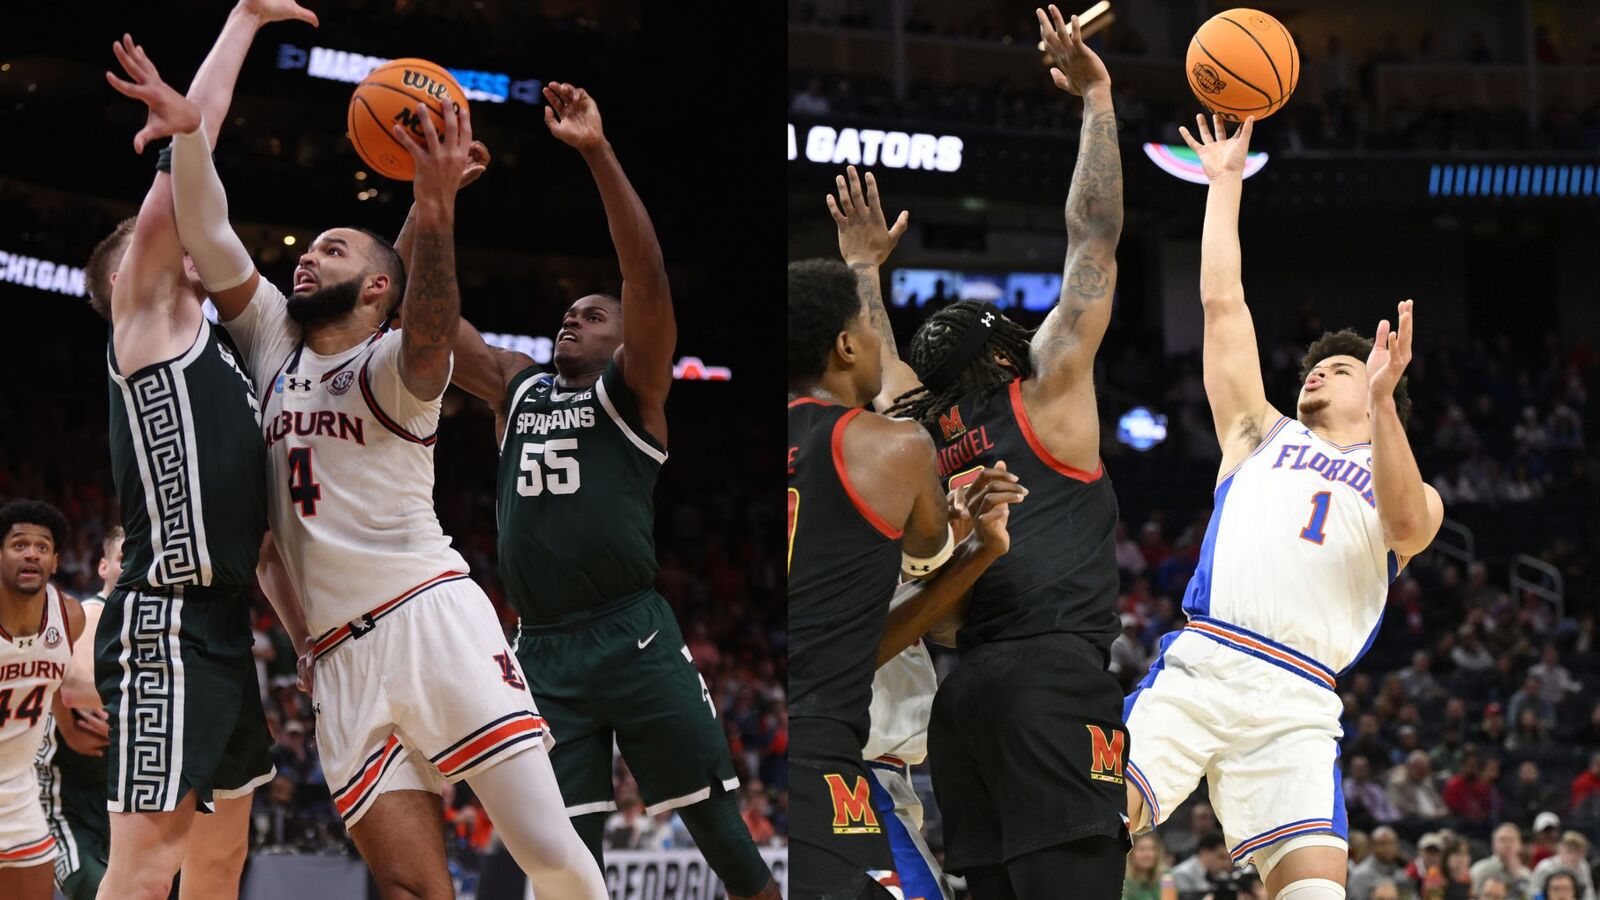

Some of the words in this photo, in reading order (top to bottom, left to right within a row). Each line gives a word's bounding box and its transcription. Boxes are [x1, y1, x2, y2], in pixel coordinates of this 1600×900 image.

[806, 126, 963, 172] GATORS
[288, 447, 321, 517] 4
[517, 438, 580, 497] 55
[1300, 491, 1331, 545] 1
[1086, 725, 1125, 777] M
[824, 774, 879, 826] M
